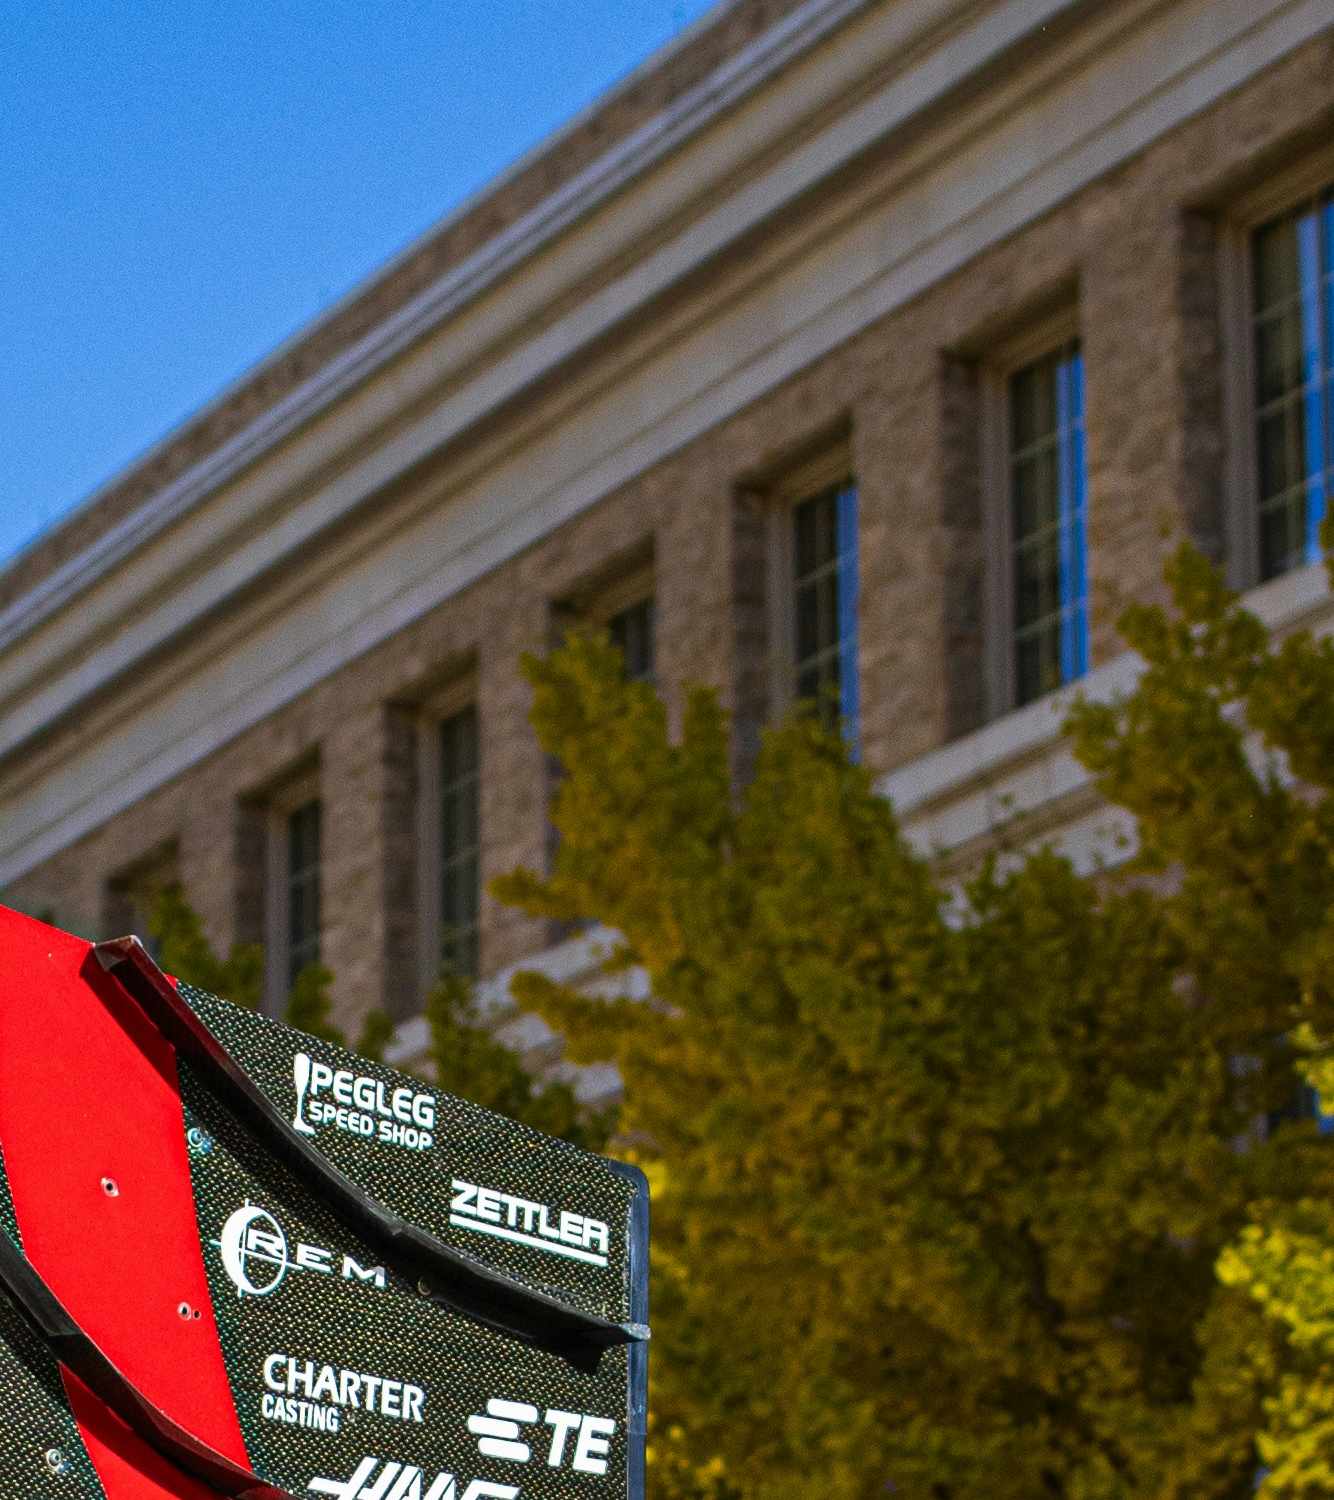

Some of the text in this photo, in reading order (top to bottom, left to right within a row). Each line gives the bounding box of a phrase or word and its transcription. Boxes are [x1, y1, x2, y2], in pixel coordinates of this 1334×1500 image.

[309, 1102, 433, 1150] SPEED SHOP
[311, 1062, 435, 1128] PEGLEG
[450, 1179, 609, 1252] ZETTLER
[261, 1394, 339, 1432] CASTING
[263, 1353, 426, 1423] CHARTER
[543, 1408, 617, 1475] TE
